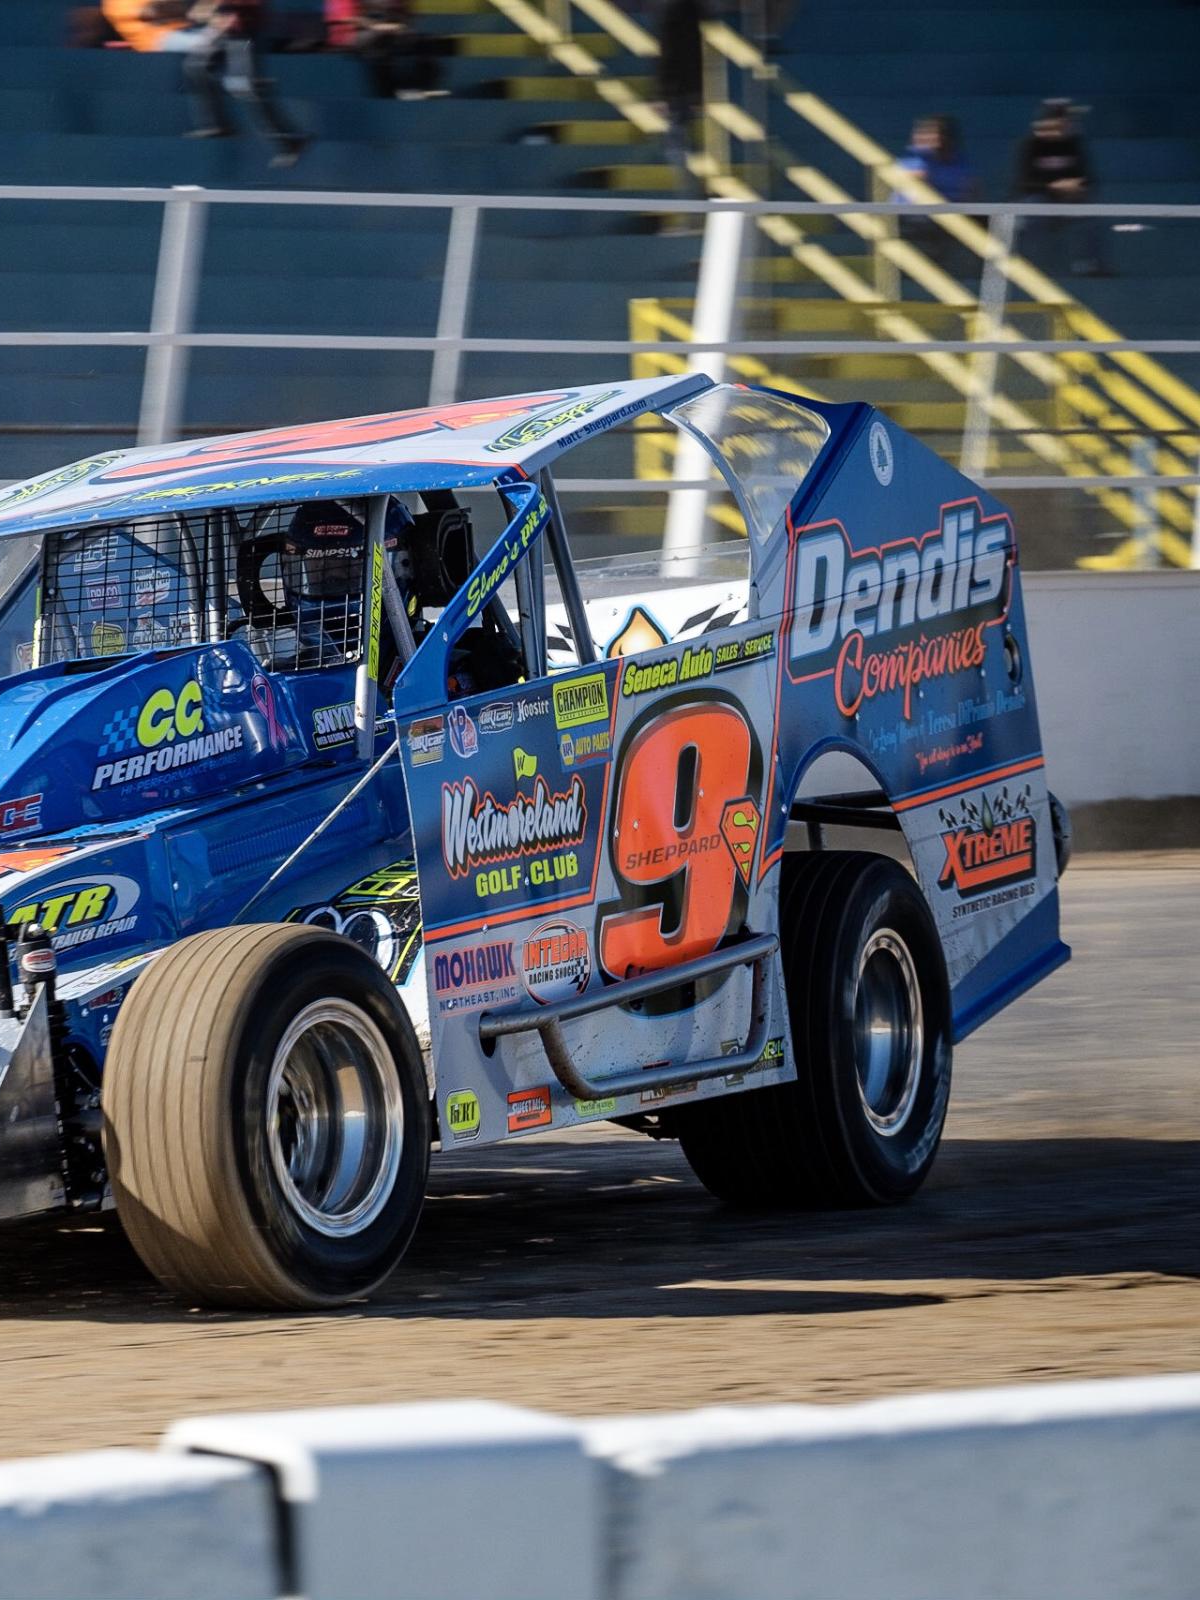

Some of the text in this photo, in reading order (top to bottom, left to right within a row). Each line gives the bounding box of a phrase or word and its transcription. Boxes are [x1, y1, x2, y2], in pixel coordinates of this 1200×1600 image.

[790, 508, 1007, 661] Dendis
[623, 658, 678, 697] Seneca
[678, 645, 714, 681] Auto
[716, 642, 738, 664] SALES
[744, 634, 772, 657] SERVICE
[834, 621, 987, 720] Companies
[314, 703, 356, 735] SNYD
[557, 683, 605, 713] CHAMPION
[91, 725, 243, 791] PERFORMANCE
[443, 778, 584, 870] Westmoreland
[597, 697, 757, 988] 9
[475, 853, 579, 898] GOLF CLUB
[625, 834, 721, 871] SHEPPARD
[50, 915, 138, 950] TRAILER REPAIR
[523, 930, 588, 972] INTEGRA
[434, 942, 516, 991] MOHAWK
[528, 964, 579, 986] RACING SHOCKS
